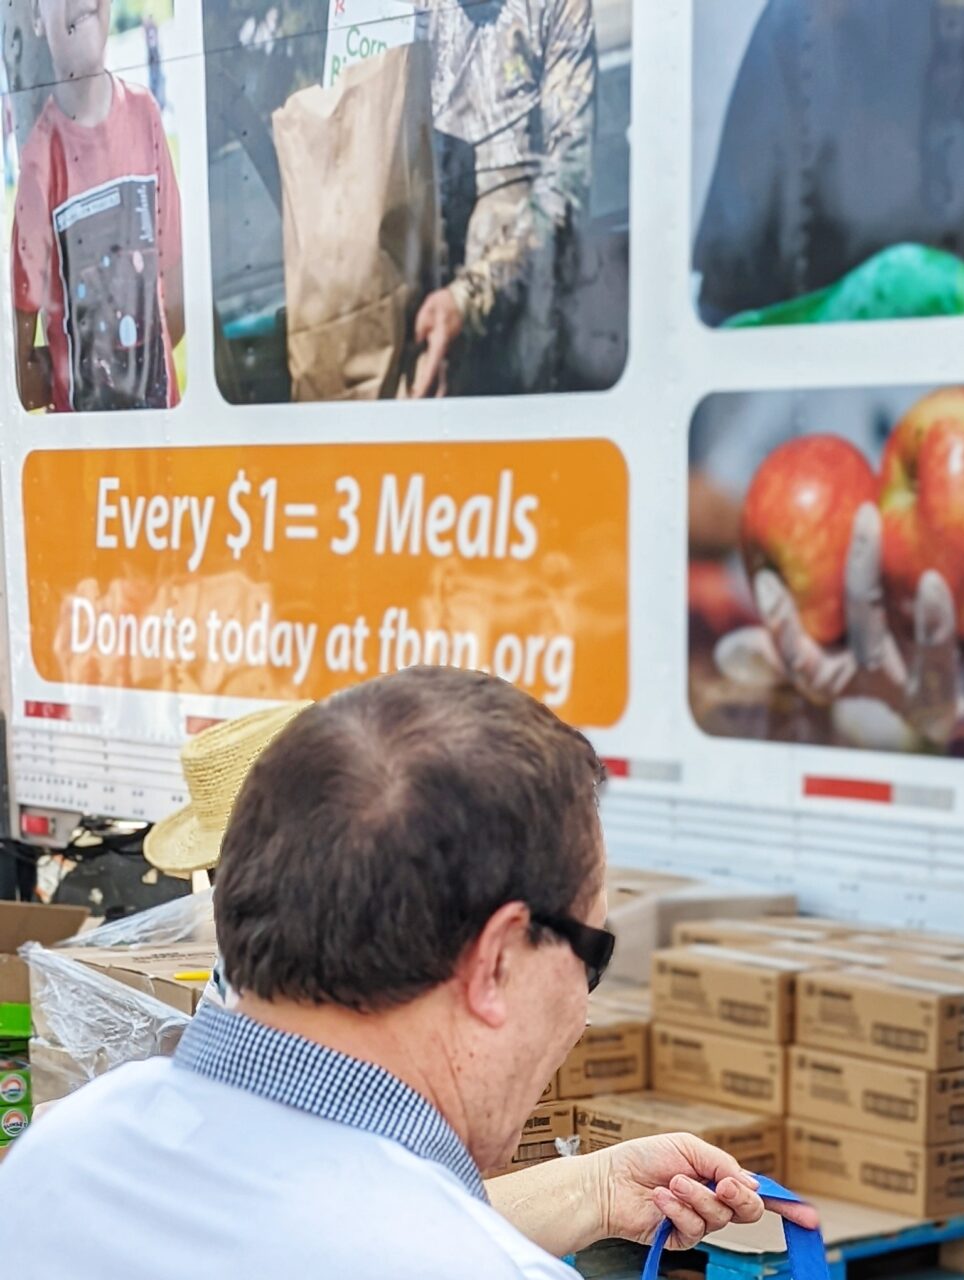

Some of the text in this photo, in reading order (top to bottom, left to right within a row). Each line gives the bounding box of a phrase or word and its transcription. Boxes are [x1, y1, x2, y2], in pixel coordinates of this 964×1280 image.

[96, 477, 215, 572] Every
[331, 476, 360, 555] 3
[374, 470, 539, 559] Meals
[70, 597, 197, 661] Donate
[206, 602, 317, 685] today
[325, 617, 370, 674] at
